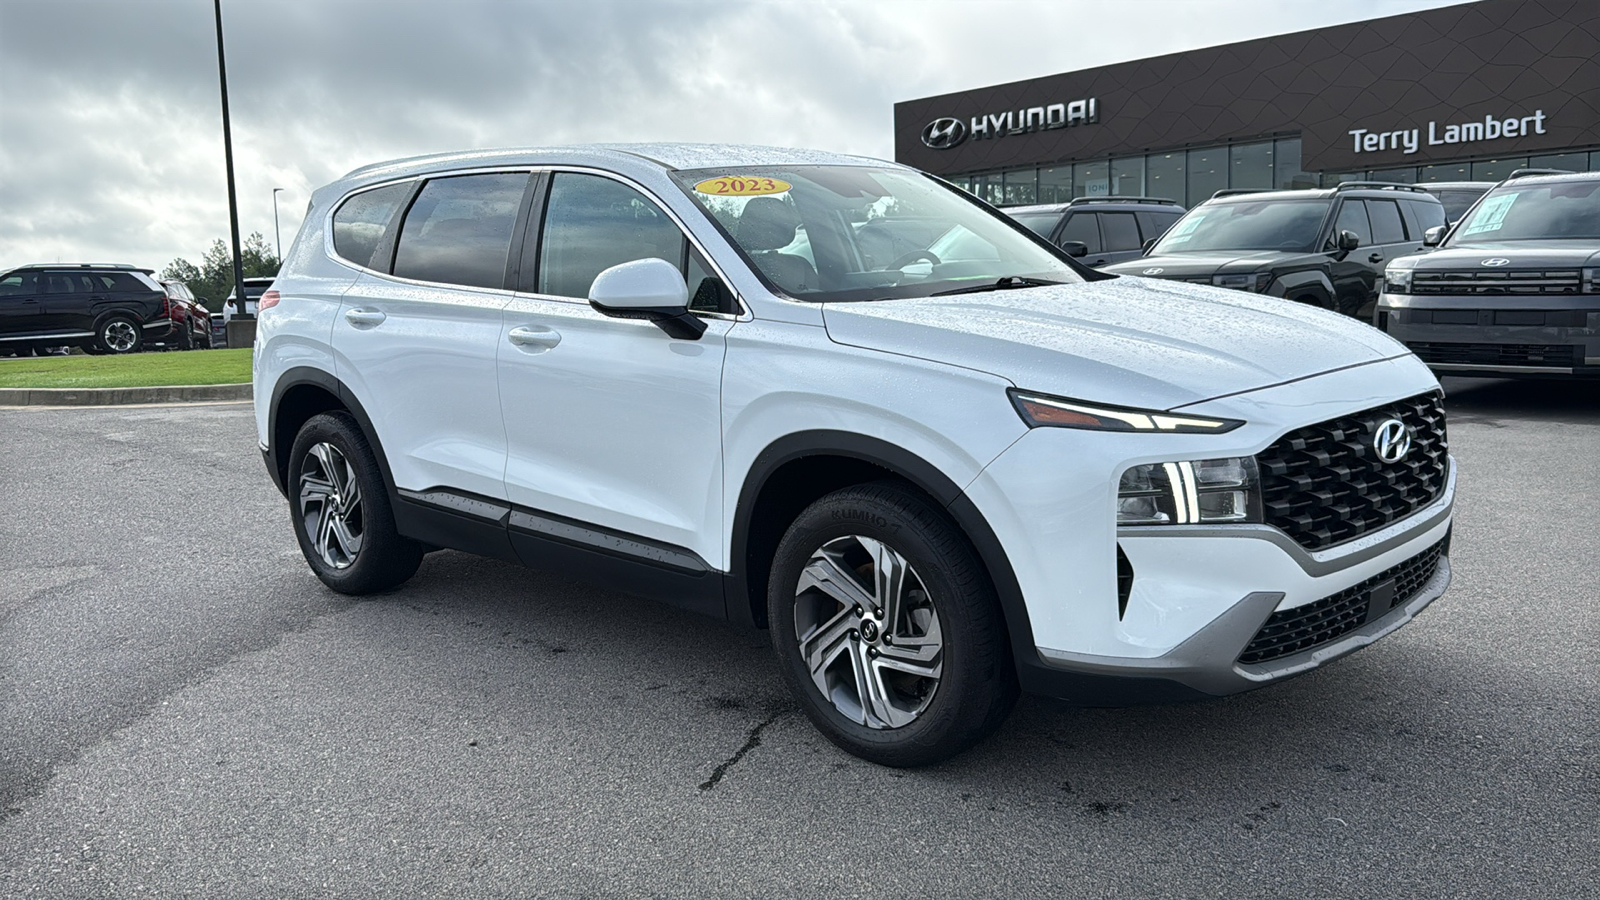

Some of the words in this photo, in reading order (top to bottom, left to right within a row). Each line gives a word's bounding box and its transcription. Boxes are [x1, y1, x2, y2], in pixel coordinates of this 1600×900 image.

[971, 98, 1096, 137] HYUNDAI
[1348, 128, 1419, 154] Terry
[1428, 110, 1546, 146] Lambert
[714, 179, 776, 193] 2023
[831, 509, 888, 528] KUMHO
